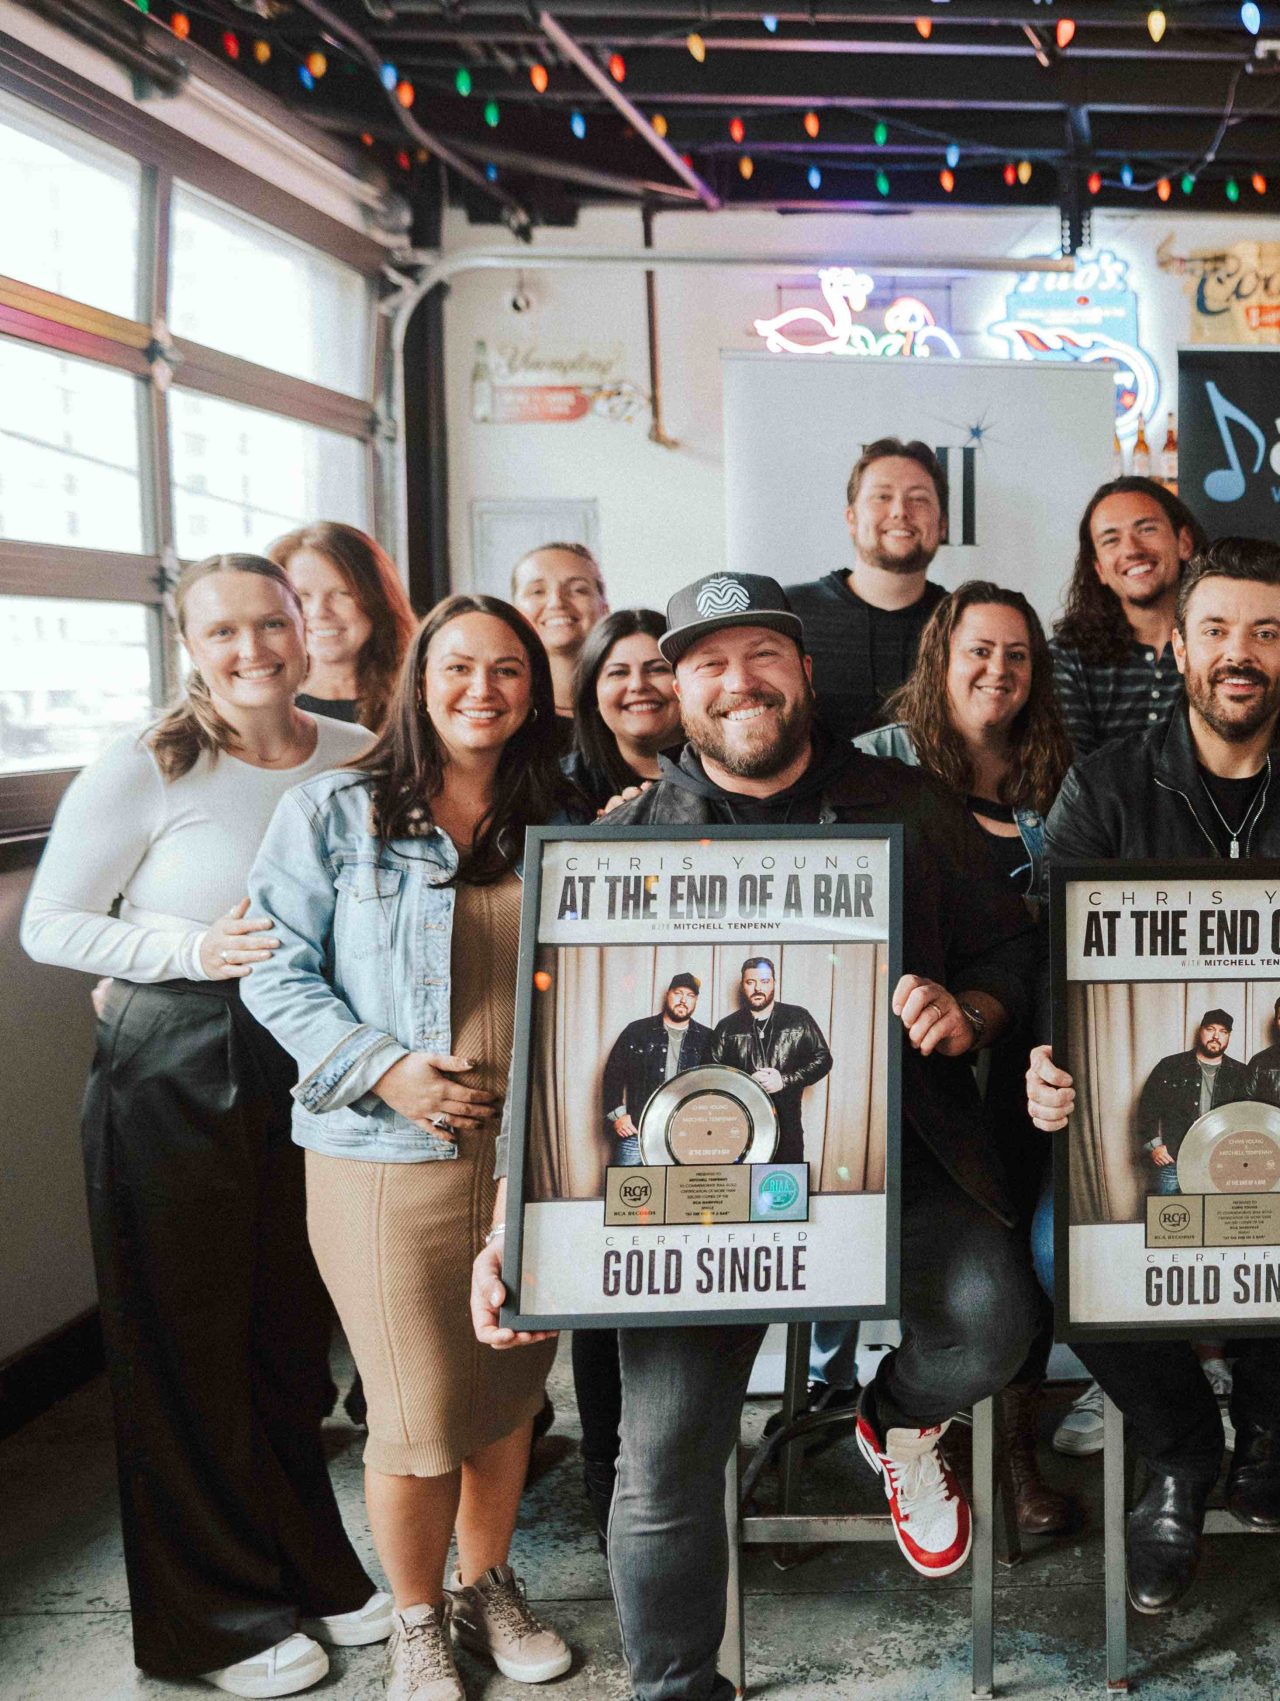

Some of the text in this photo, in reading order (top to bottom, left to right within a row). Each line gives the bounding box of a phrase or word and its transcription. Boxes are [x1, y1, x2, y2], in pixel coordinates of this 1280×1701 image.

[566, 855, 871, 871] CHRIS YOUNG
[557, 873, 874, 920] AT THE END OF A BAR
[1089, 890, 1223, 905] CHRIS
[673, 923, 724, 931] MITCHELL
[727, 922, 781, 930] TENPENNY
[1083, 910, 1121, 957] AT
[1130, 909, 1187, 957] THE
[1199, 908, 1259, 956] END
[1204, 959, 1257, 967] MITCHELL
[623, 1185, 649, 1201] RCA
[1163, 1213, 1187, 1227] RCA
[605, 1231, 808, 1247] CERTIFIED
[602, 1245, 807, 1296] GOLD SINGLE
[1145, 1265, 1221, 1306] GOLD
